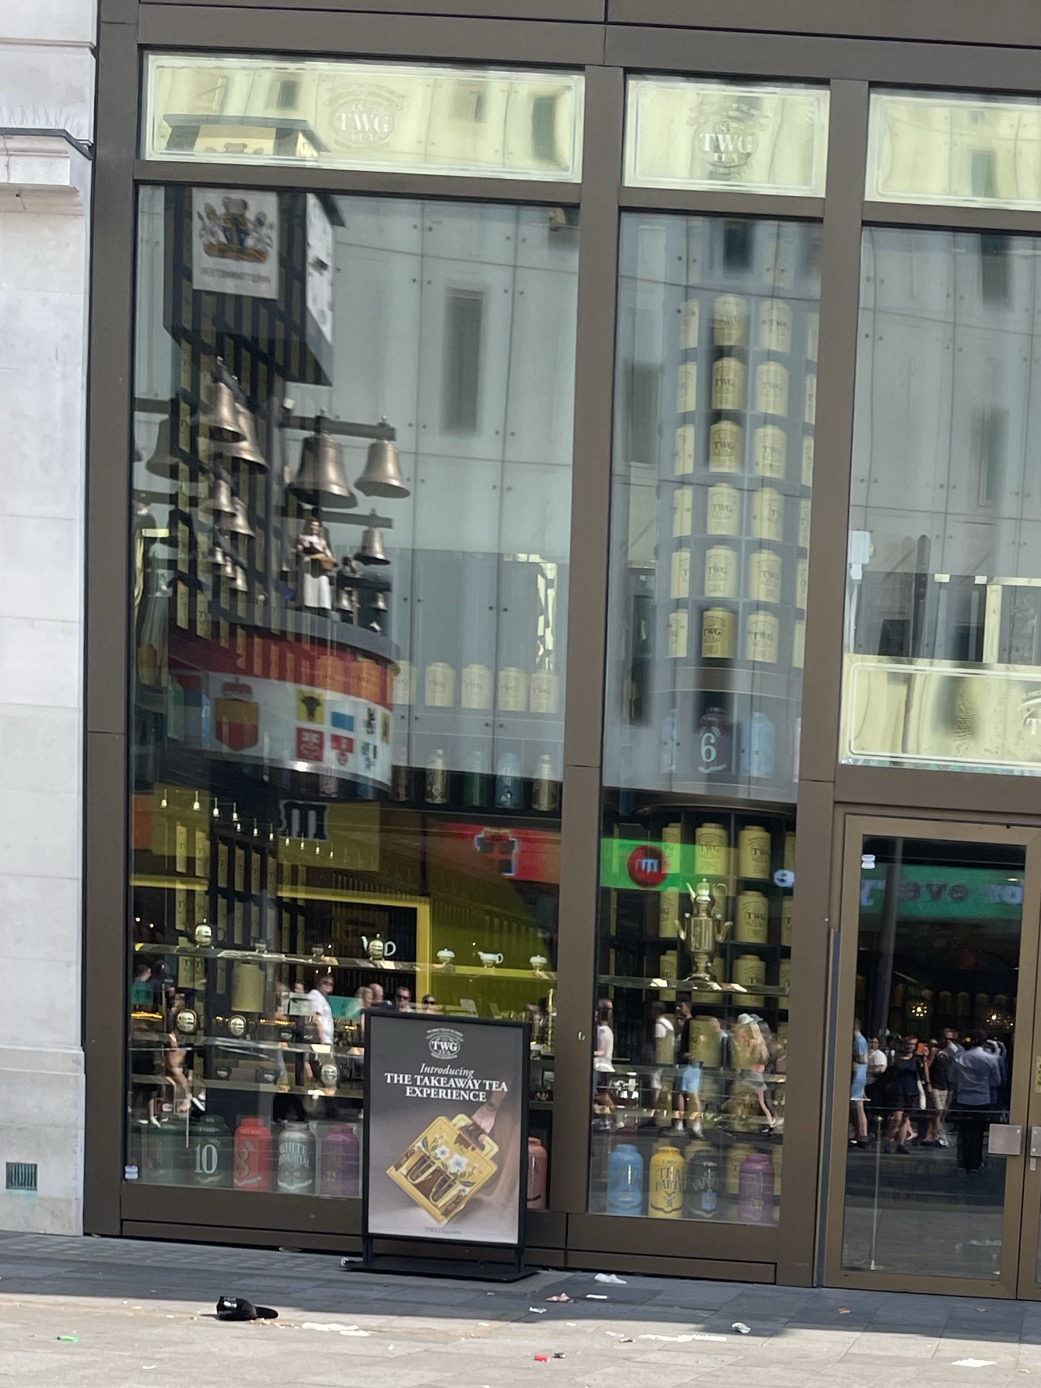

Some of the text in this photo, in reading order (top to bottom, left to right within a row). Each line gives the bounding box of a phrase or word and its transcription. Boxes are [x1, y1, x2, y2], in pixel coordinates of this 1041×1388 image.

[336, 112, 389, 132] TWG
[699, 133, 752, 153] TWG
[700, 733, 717, 763] 6
[432, 1041, 457, 1052] TWG
[420, 1064, 474, 1078] Introducing
[384, 1073, 508, 1092] THE TAKEAWAY TEA
[406, 1086, 487, 1102] EXPERIENCE
[194, 1144, 218, 1174] 10
[657, 1168, 682, 1180] TEA
